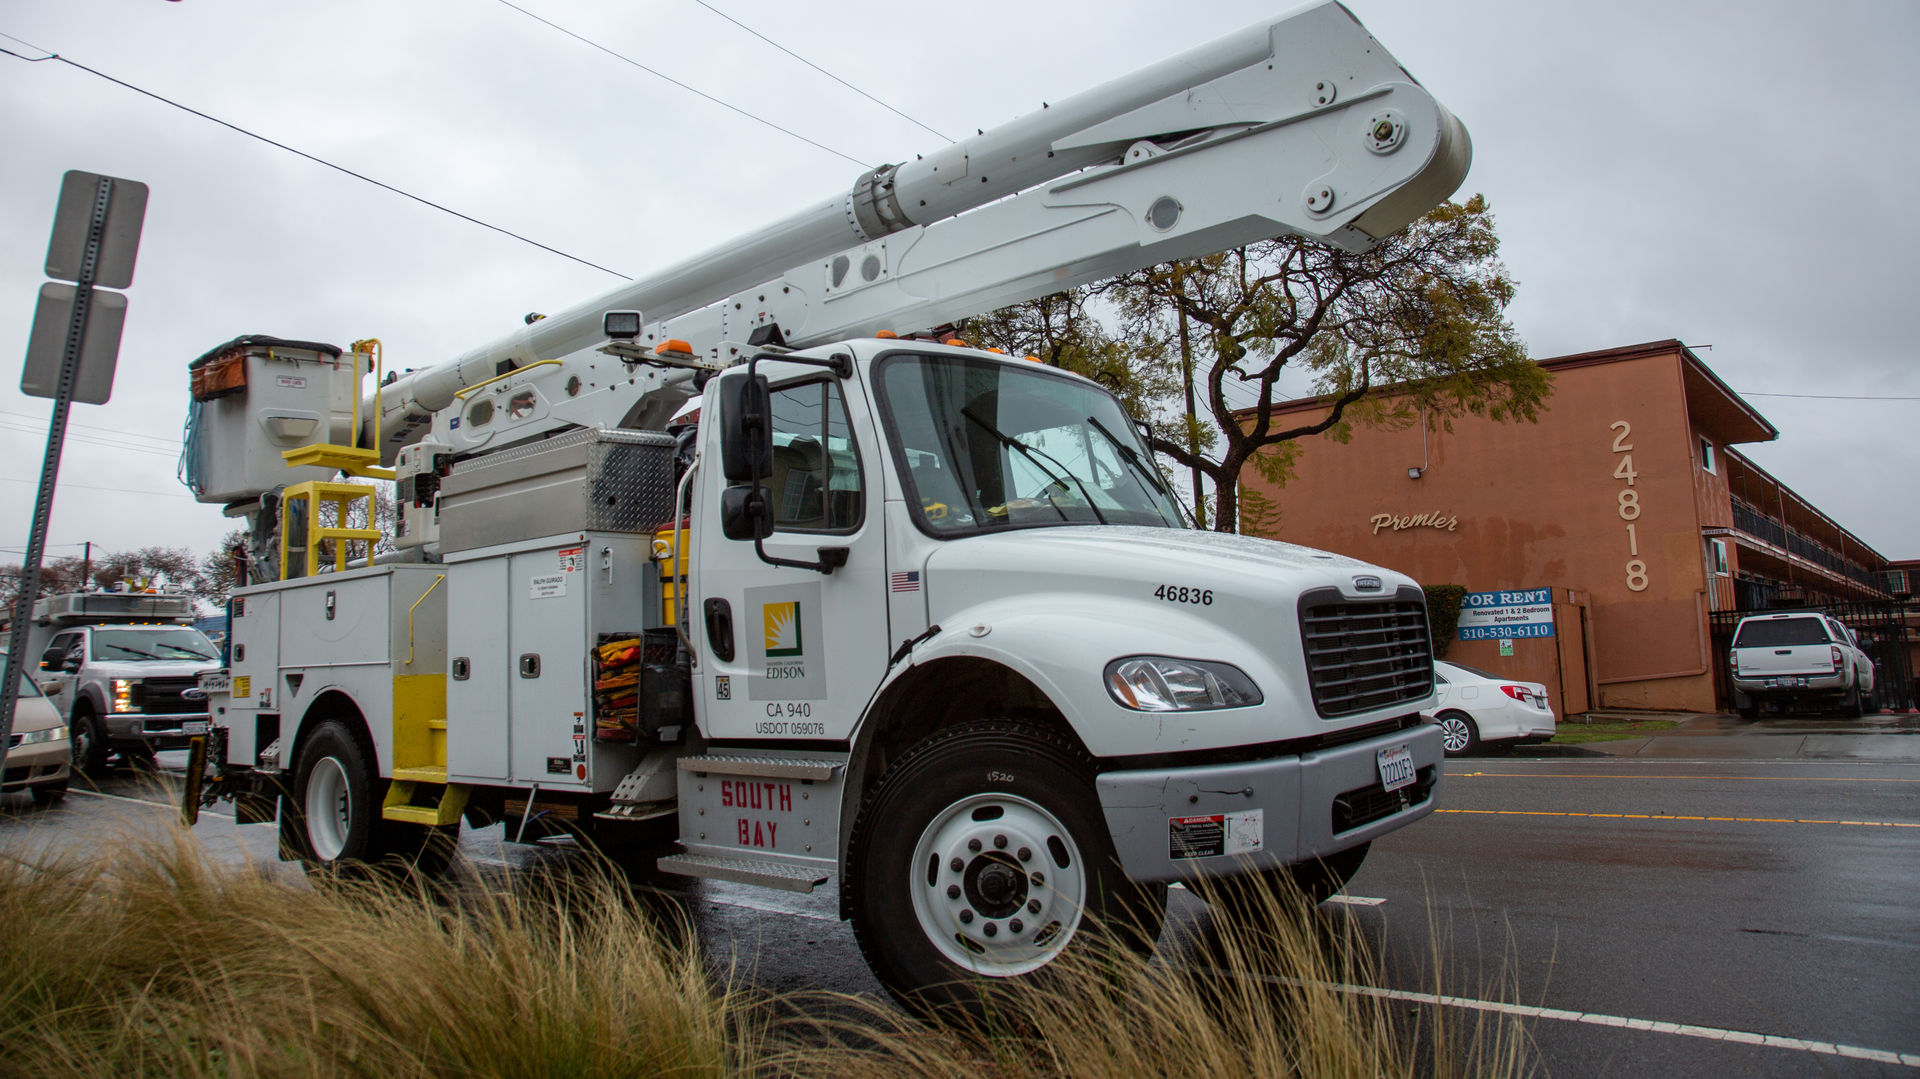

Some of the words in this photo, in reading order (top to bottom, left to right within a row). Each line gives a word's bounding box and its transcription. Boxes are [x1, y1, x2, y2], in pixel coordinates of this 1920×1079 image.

[1610, 420, 1649, 592] 24818
[1370, 510, 1458, 535] Premier
[1154, 584, 1213, 606] 46836
[1460, 594, 1495, 606] FOR
[1500, 590, 1547, 604] RENT
[1472, 607, 1504, 616] Renovated
[1522, 606, 1550, 614] Bedroom
[1494, 615, 1529, 623] Apartments
[1463, 624, 1548, 639] 310-530-6110
[766, 666, 805, 680] EDISON
[718, 682, 729, 698] 45
[766, 703, 783, 717] CA
[787, 702, 811, 717] 940
[755, 722, 788, 734] USDOT
[791, 722, 825, 735] 059076
[1382, 757, 1413, 785] 22211F3
[721, 780, 792, 812] SOUTH
[738, 818, 777, 848] BAY
